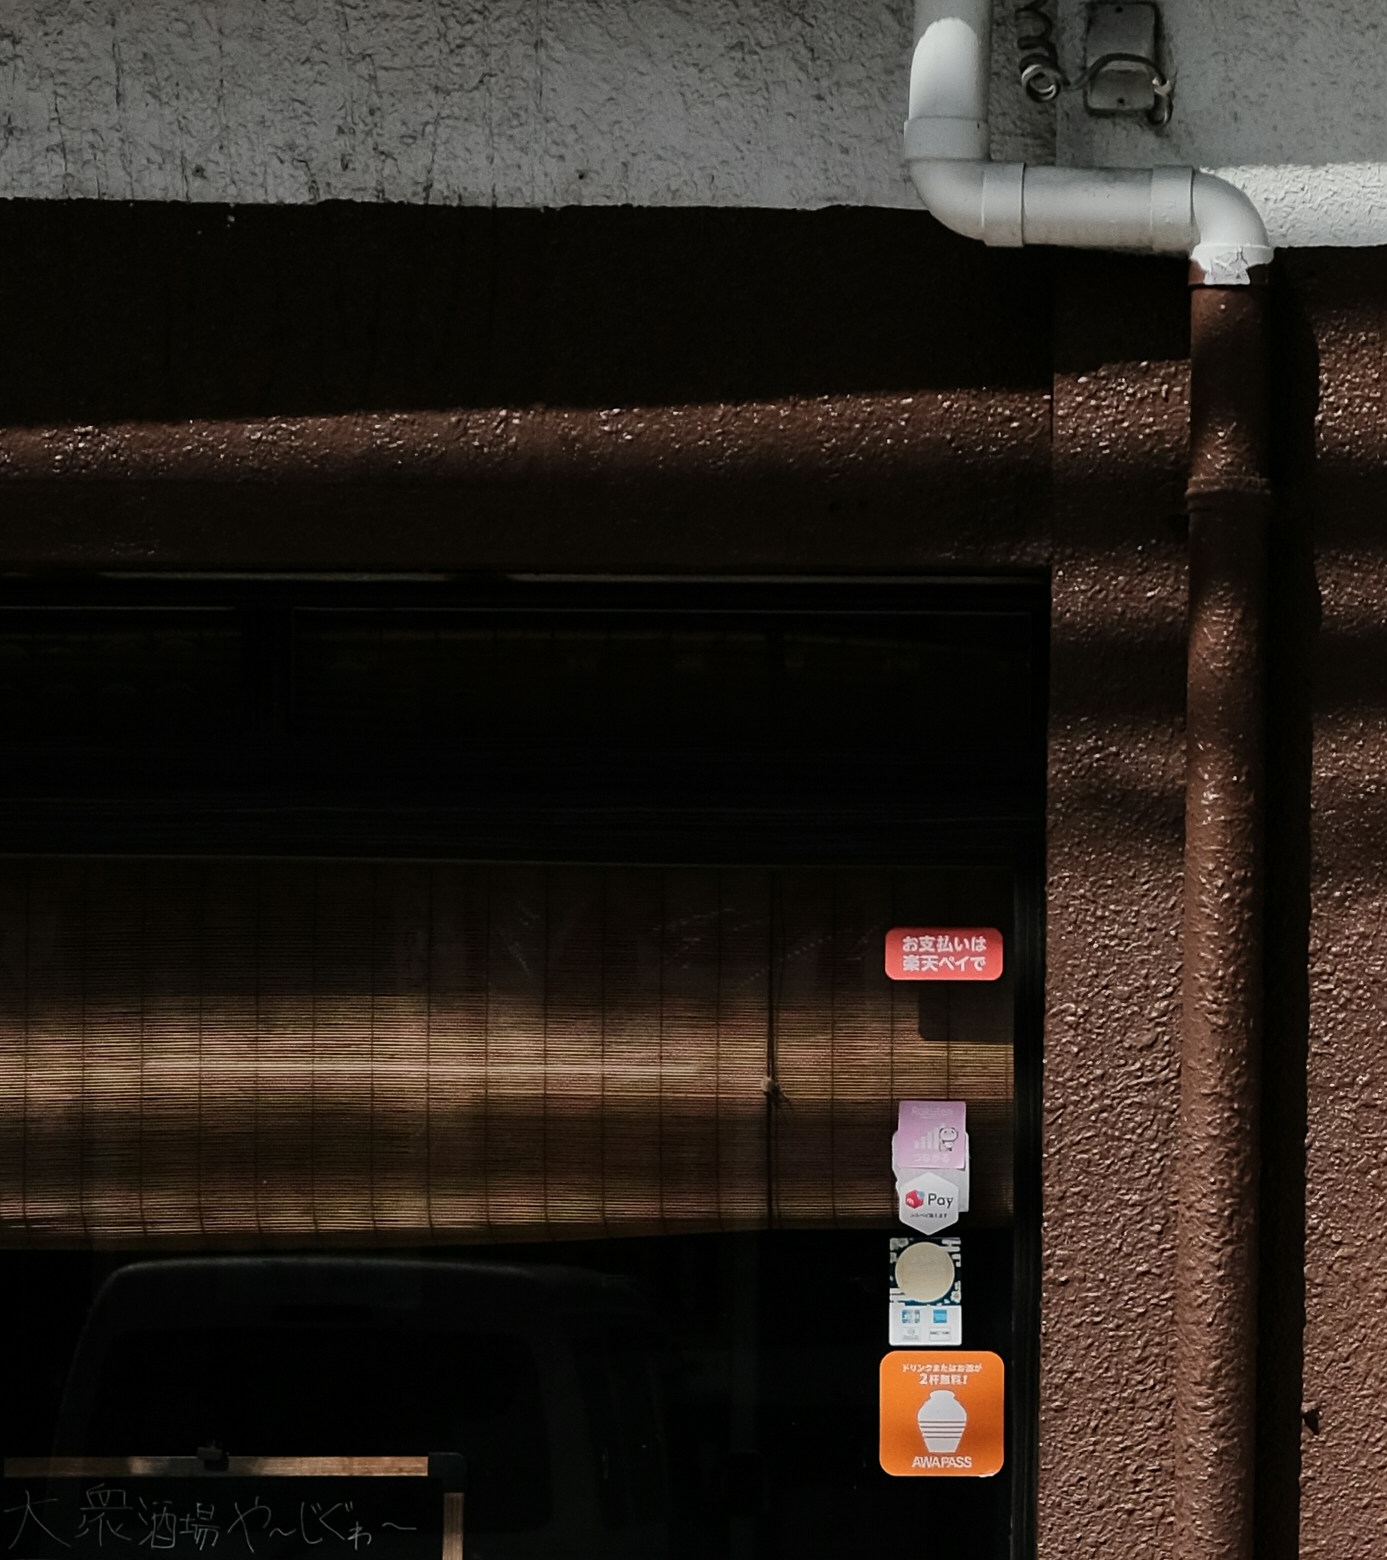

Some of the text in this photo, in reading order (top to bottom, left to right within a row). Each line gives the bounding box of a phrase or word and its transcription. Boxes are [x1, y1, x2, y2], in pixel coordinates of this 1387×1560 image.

[903, 935, 987, 953] お支払いは
[903, 955, 987, 972] 楽天ペイで
[928, 1193, 953, 1208] Pay
